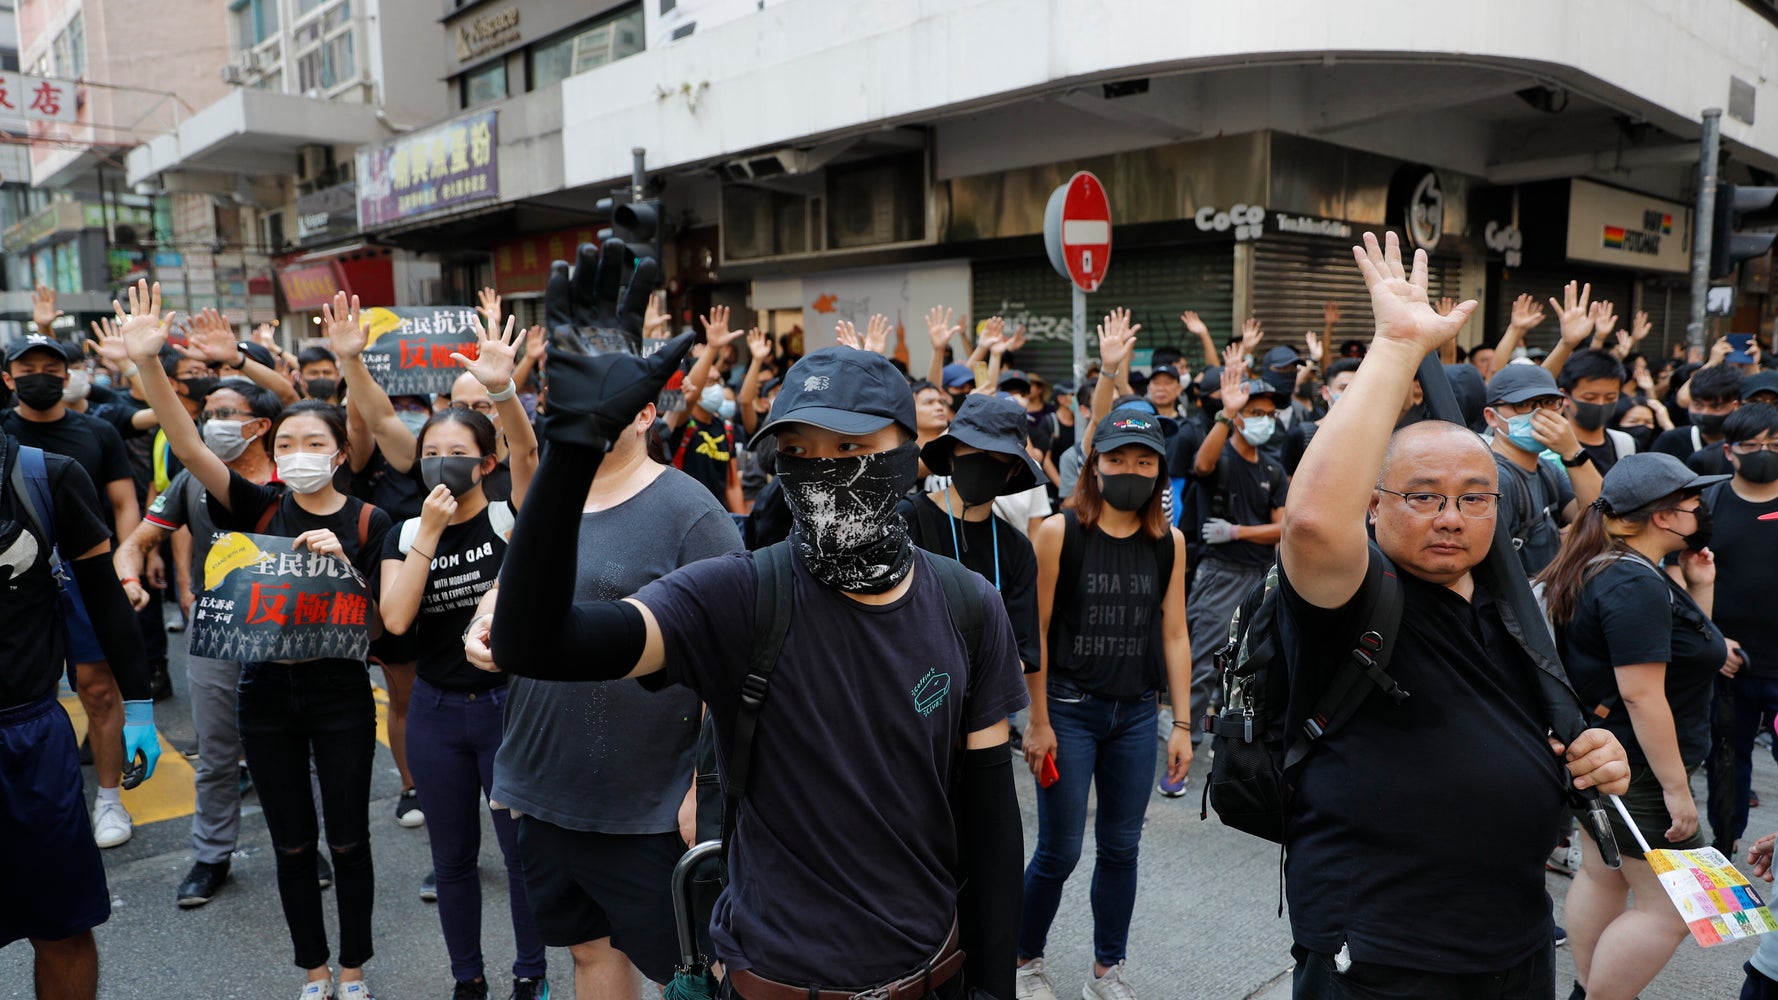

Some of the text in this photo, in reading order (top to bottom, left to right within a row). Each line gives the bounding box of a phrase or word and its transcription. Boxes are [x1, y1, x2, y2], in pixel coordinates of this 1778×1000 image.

[433, 570, 481, 589] WITH MODERATION
[441, 591, 449, 600] TO
[448, 586, 473, 599] EXPRESS
[472, 578, 496, 593] YOURSEL
[199, 597, 234, 611] 五大訴求
[244, 581, 368, 627] 反極權
[456, 597, 474, 608] WORLD
